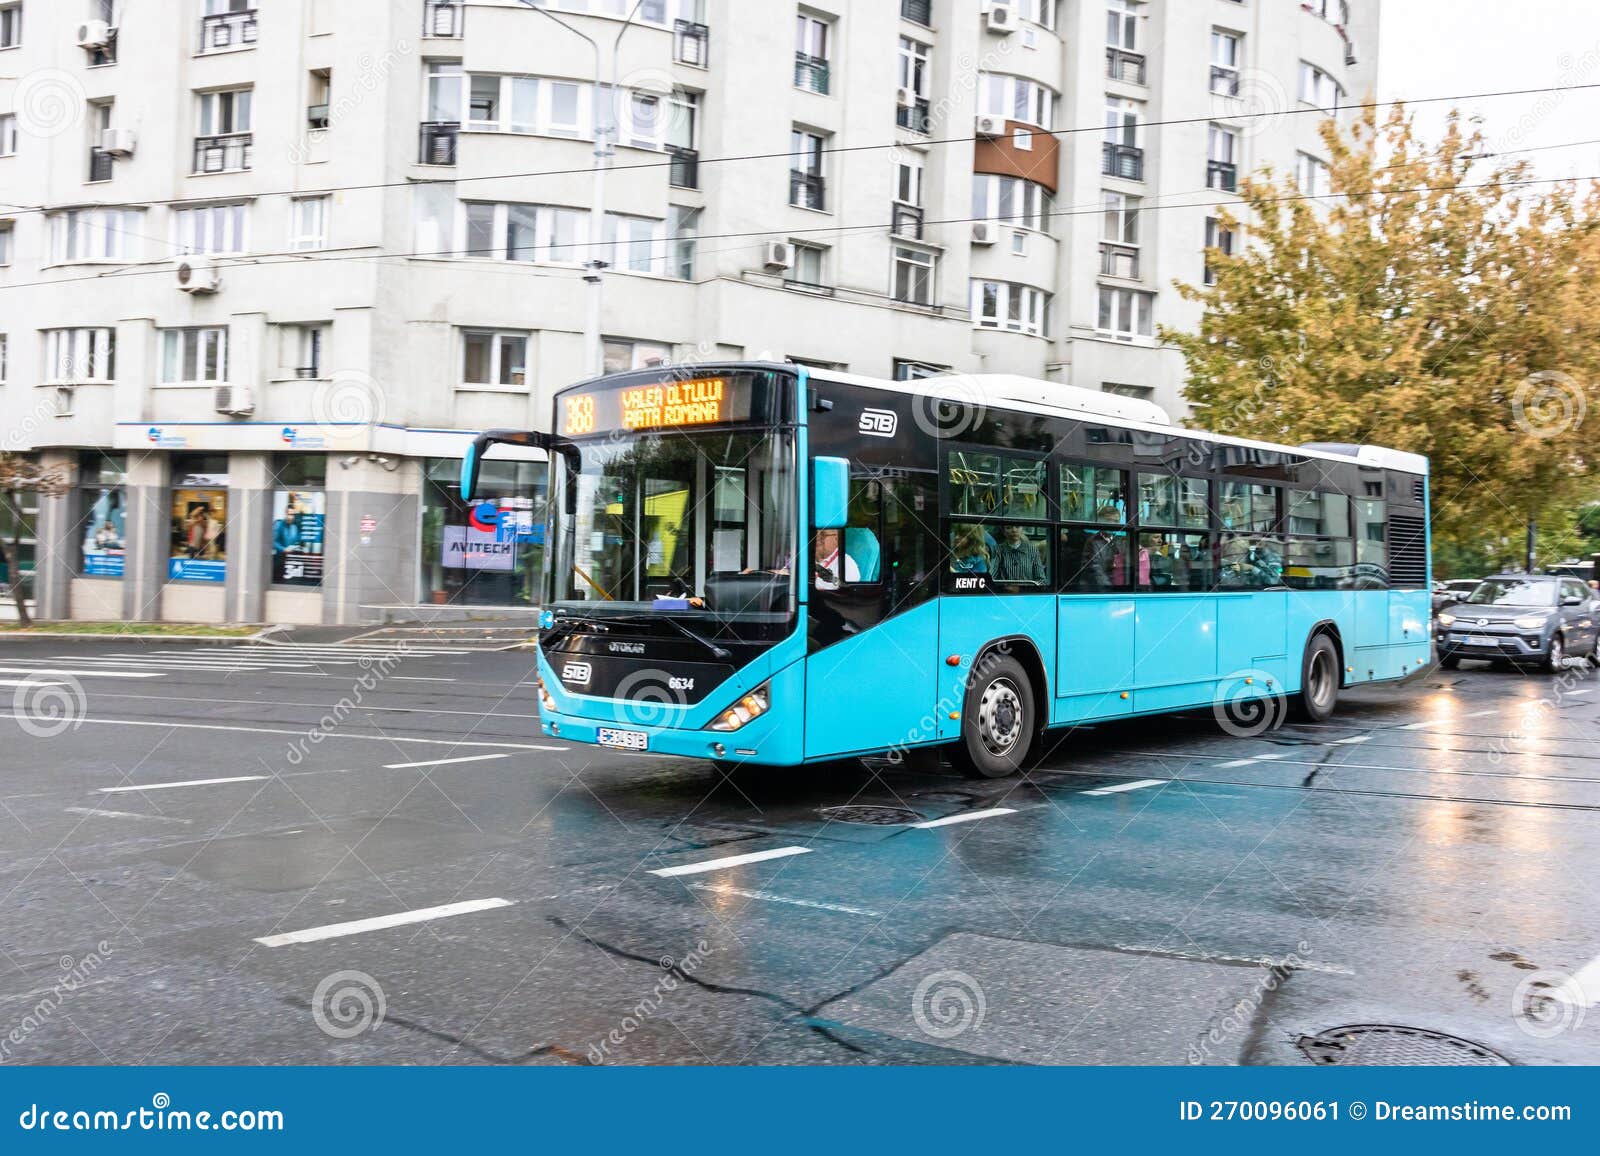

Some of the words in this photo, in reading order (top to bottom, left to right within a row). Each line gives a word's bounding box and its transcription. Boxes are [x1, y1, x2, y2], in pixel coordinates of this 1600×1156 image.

[621, 385, 664, 408] VALEA
[666, 379, 723, 404] OLTULUI
[622, 406, 662, 430] PIATA
[663, 401, 719, 426] ROMANA
[859, 409, 896, 436] STB
[450, 541, 511, 554] AVITECH
[955, 577, 978, 589] KENT
[978, 577, 986, 589] C
[608, 641, 646, 654] OTOKAR
[562, 663, 591, 683] STB
[668, 677, 695, 690] 6634
